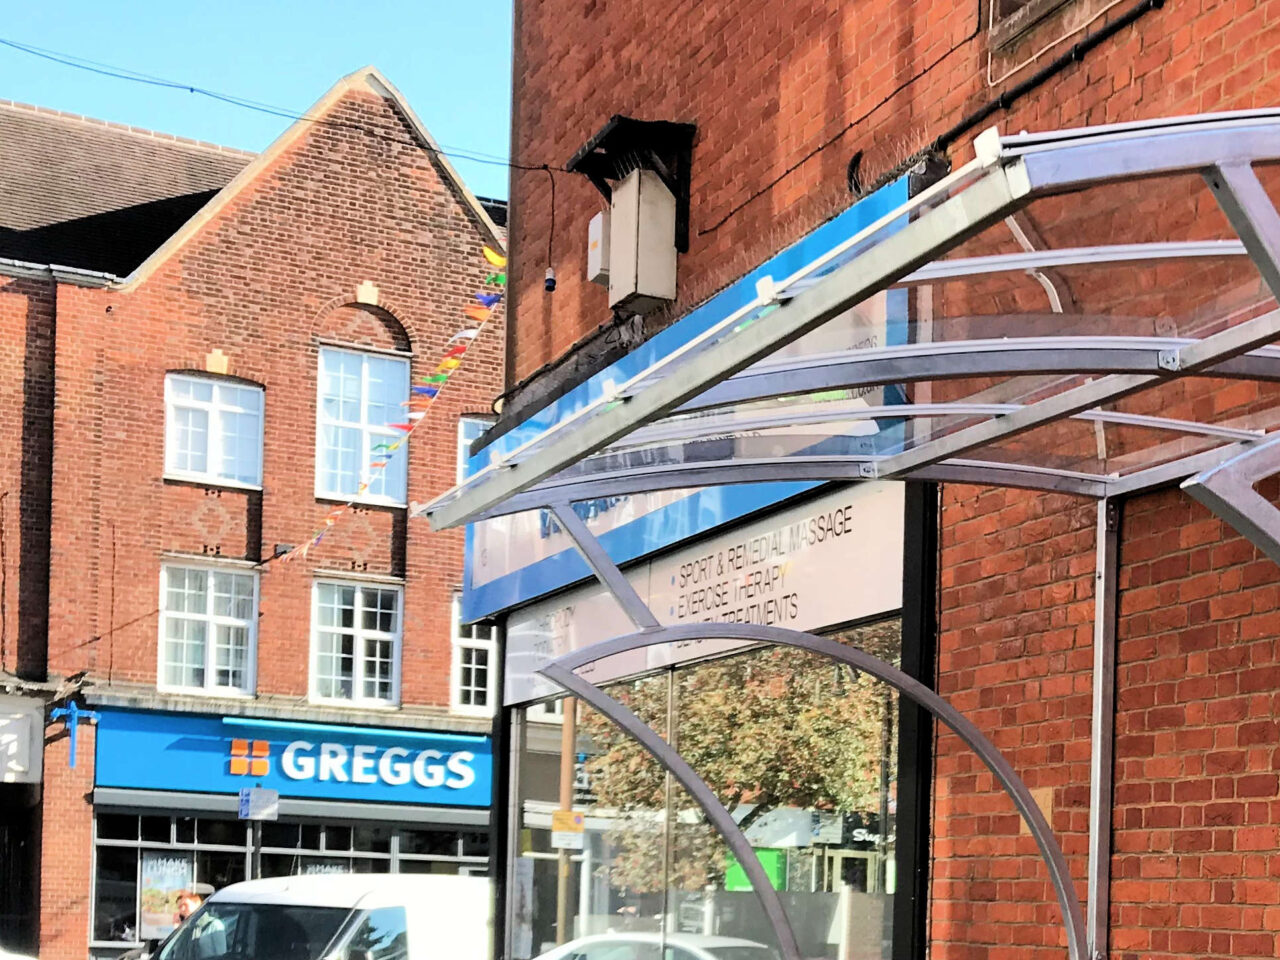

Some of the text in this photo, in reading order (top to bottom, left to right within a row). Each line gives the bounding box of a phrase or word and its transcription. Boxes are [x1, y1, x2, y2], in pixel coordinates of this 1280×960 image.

[679, 505, 853, 588] SPORT & REMEDIAL MASSAGE
[678, 563, 787, 618] EXERCISE THERAPY
[281, 740, 476, 789] GREGGS
